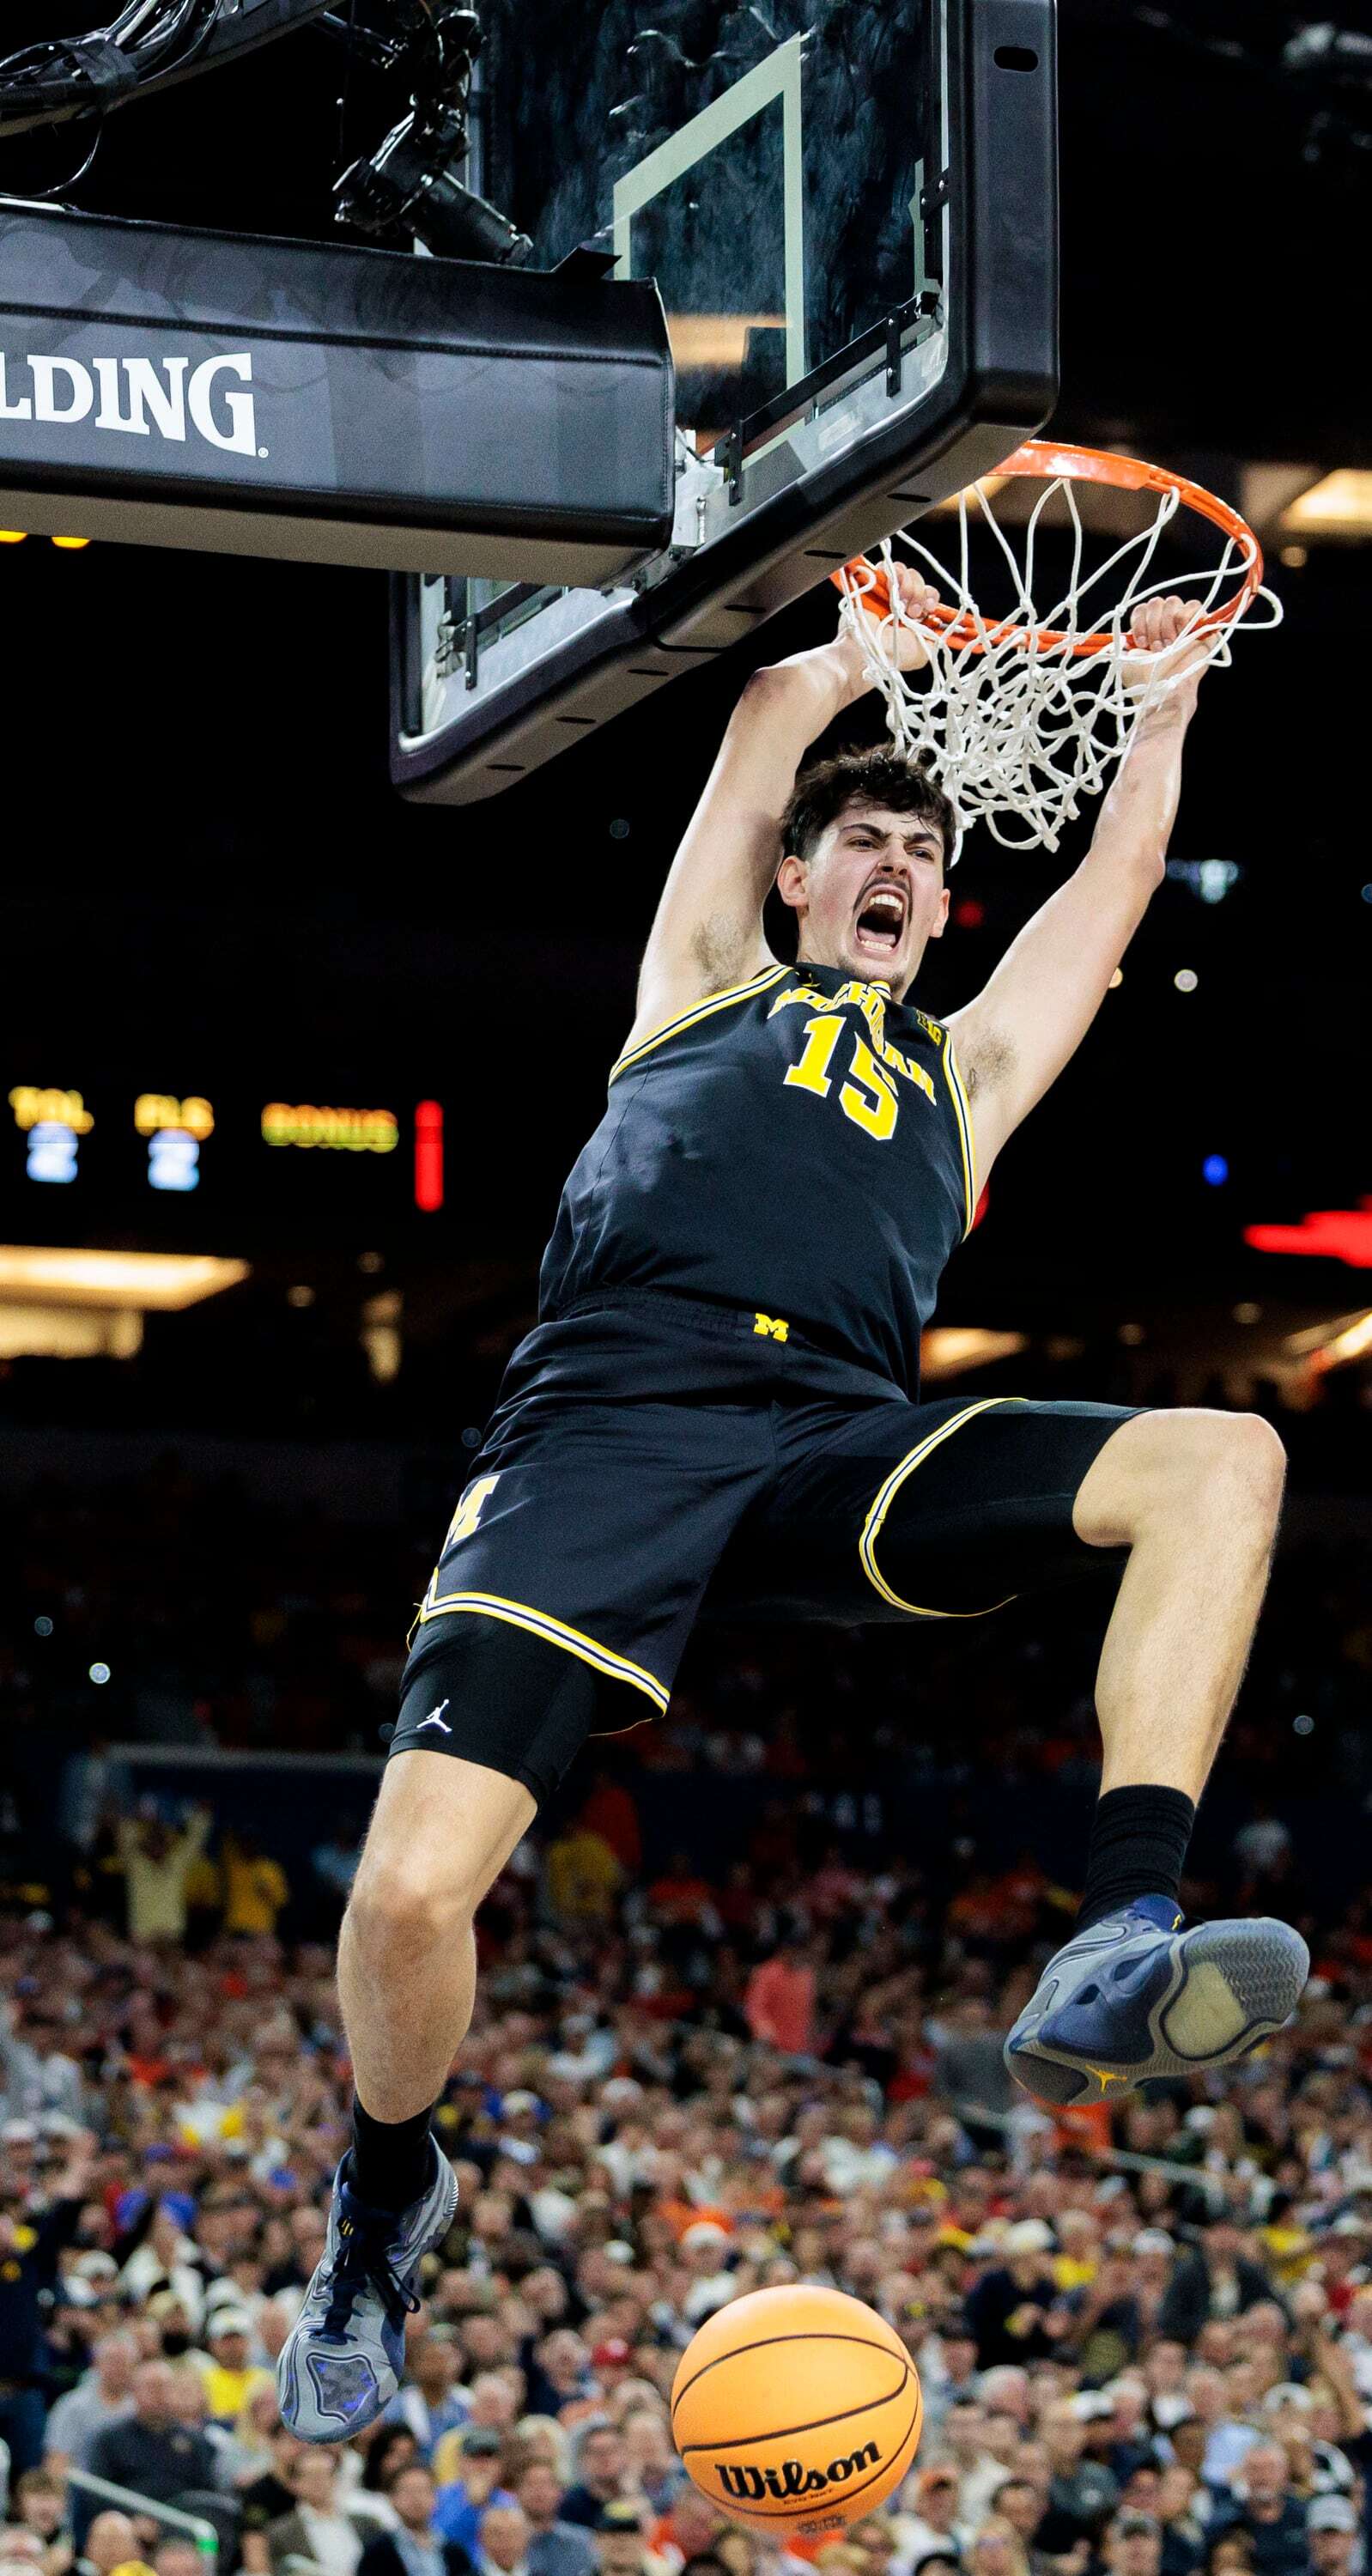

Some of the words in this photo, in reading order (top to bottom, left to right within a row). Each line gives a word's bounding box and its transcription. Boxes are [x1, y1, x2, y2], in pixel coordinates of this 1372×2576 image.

[783, 1015, 898, 1140] 15
[754, 1313, 789, 1342] M
[714, 2440, 883, 2500] Wilson
